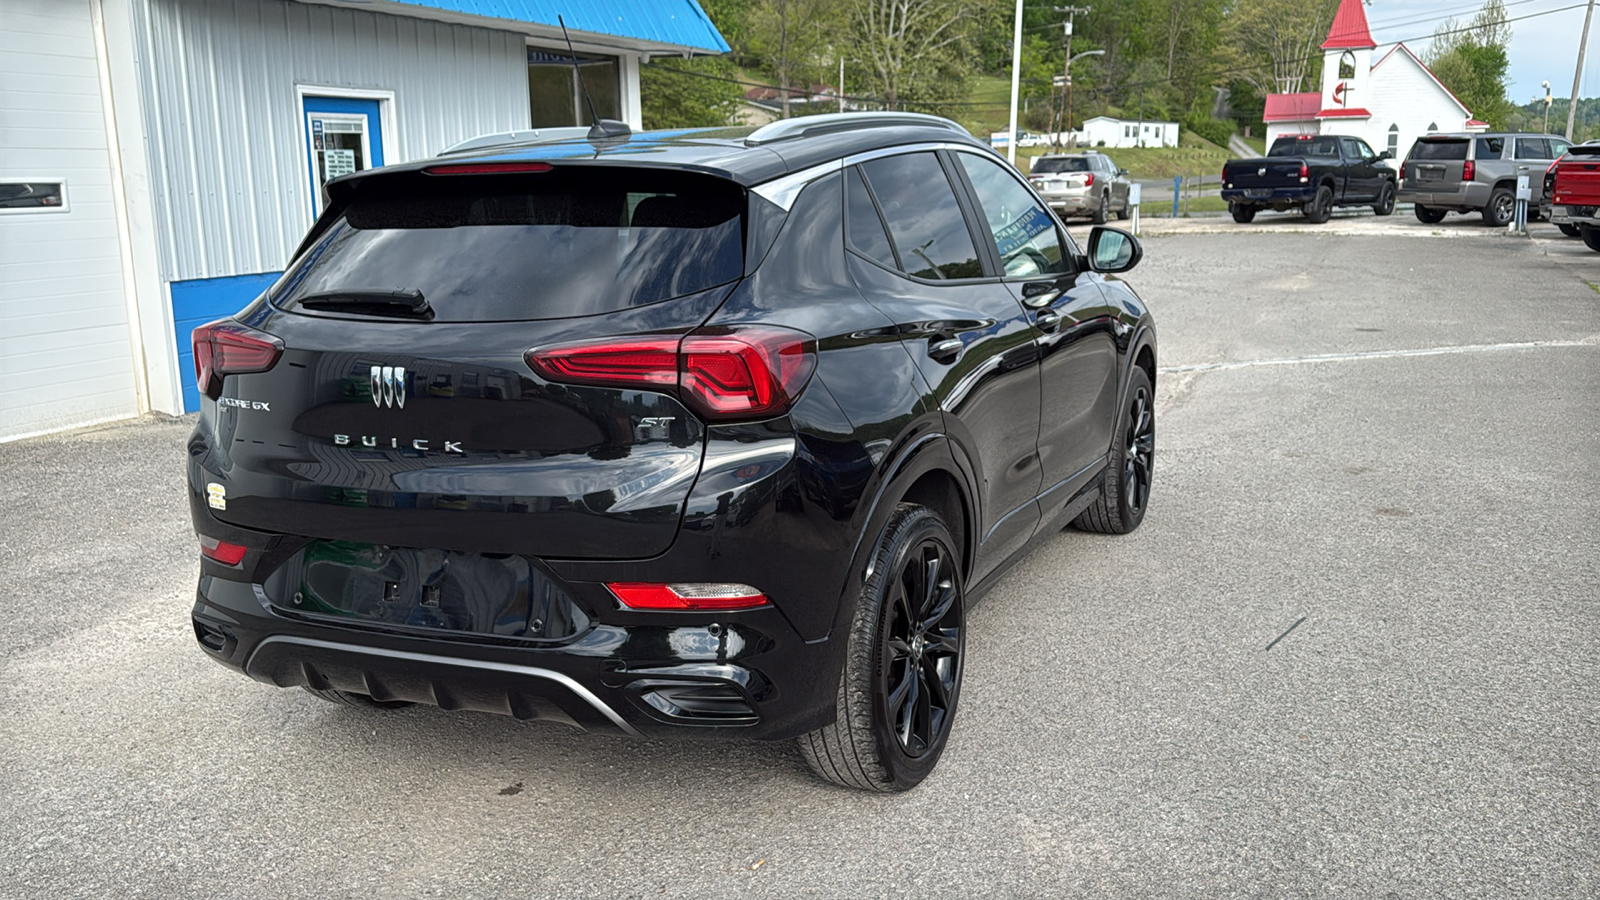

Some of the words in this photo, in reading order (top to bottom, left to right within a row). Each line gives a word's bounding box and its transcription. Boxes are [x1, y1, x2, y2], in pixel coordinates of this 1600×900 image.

[252, 401, 271, 412] GX
[637, 416, 676, 427] ST
[334, 434, 463, 453] BUICK
